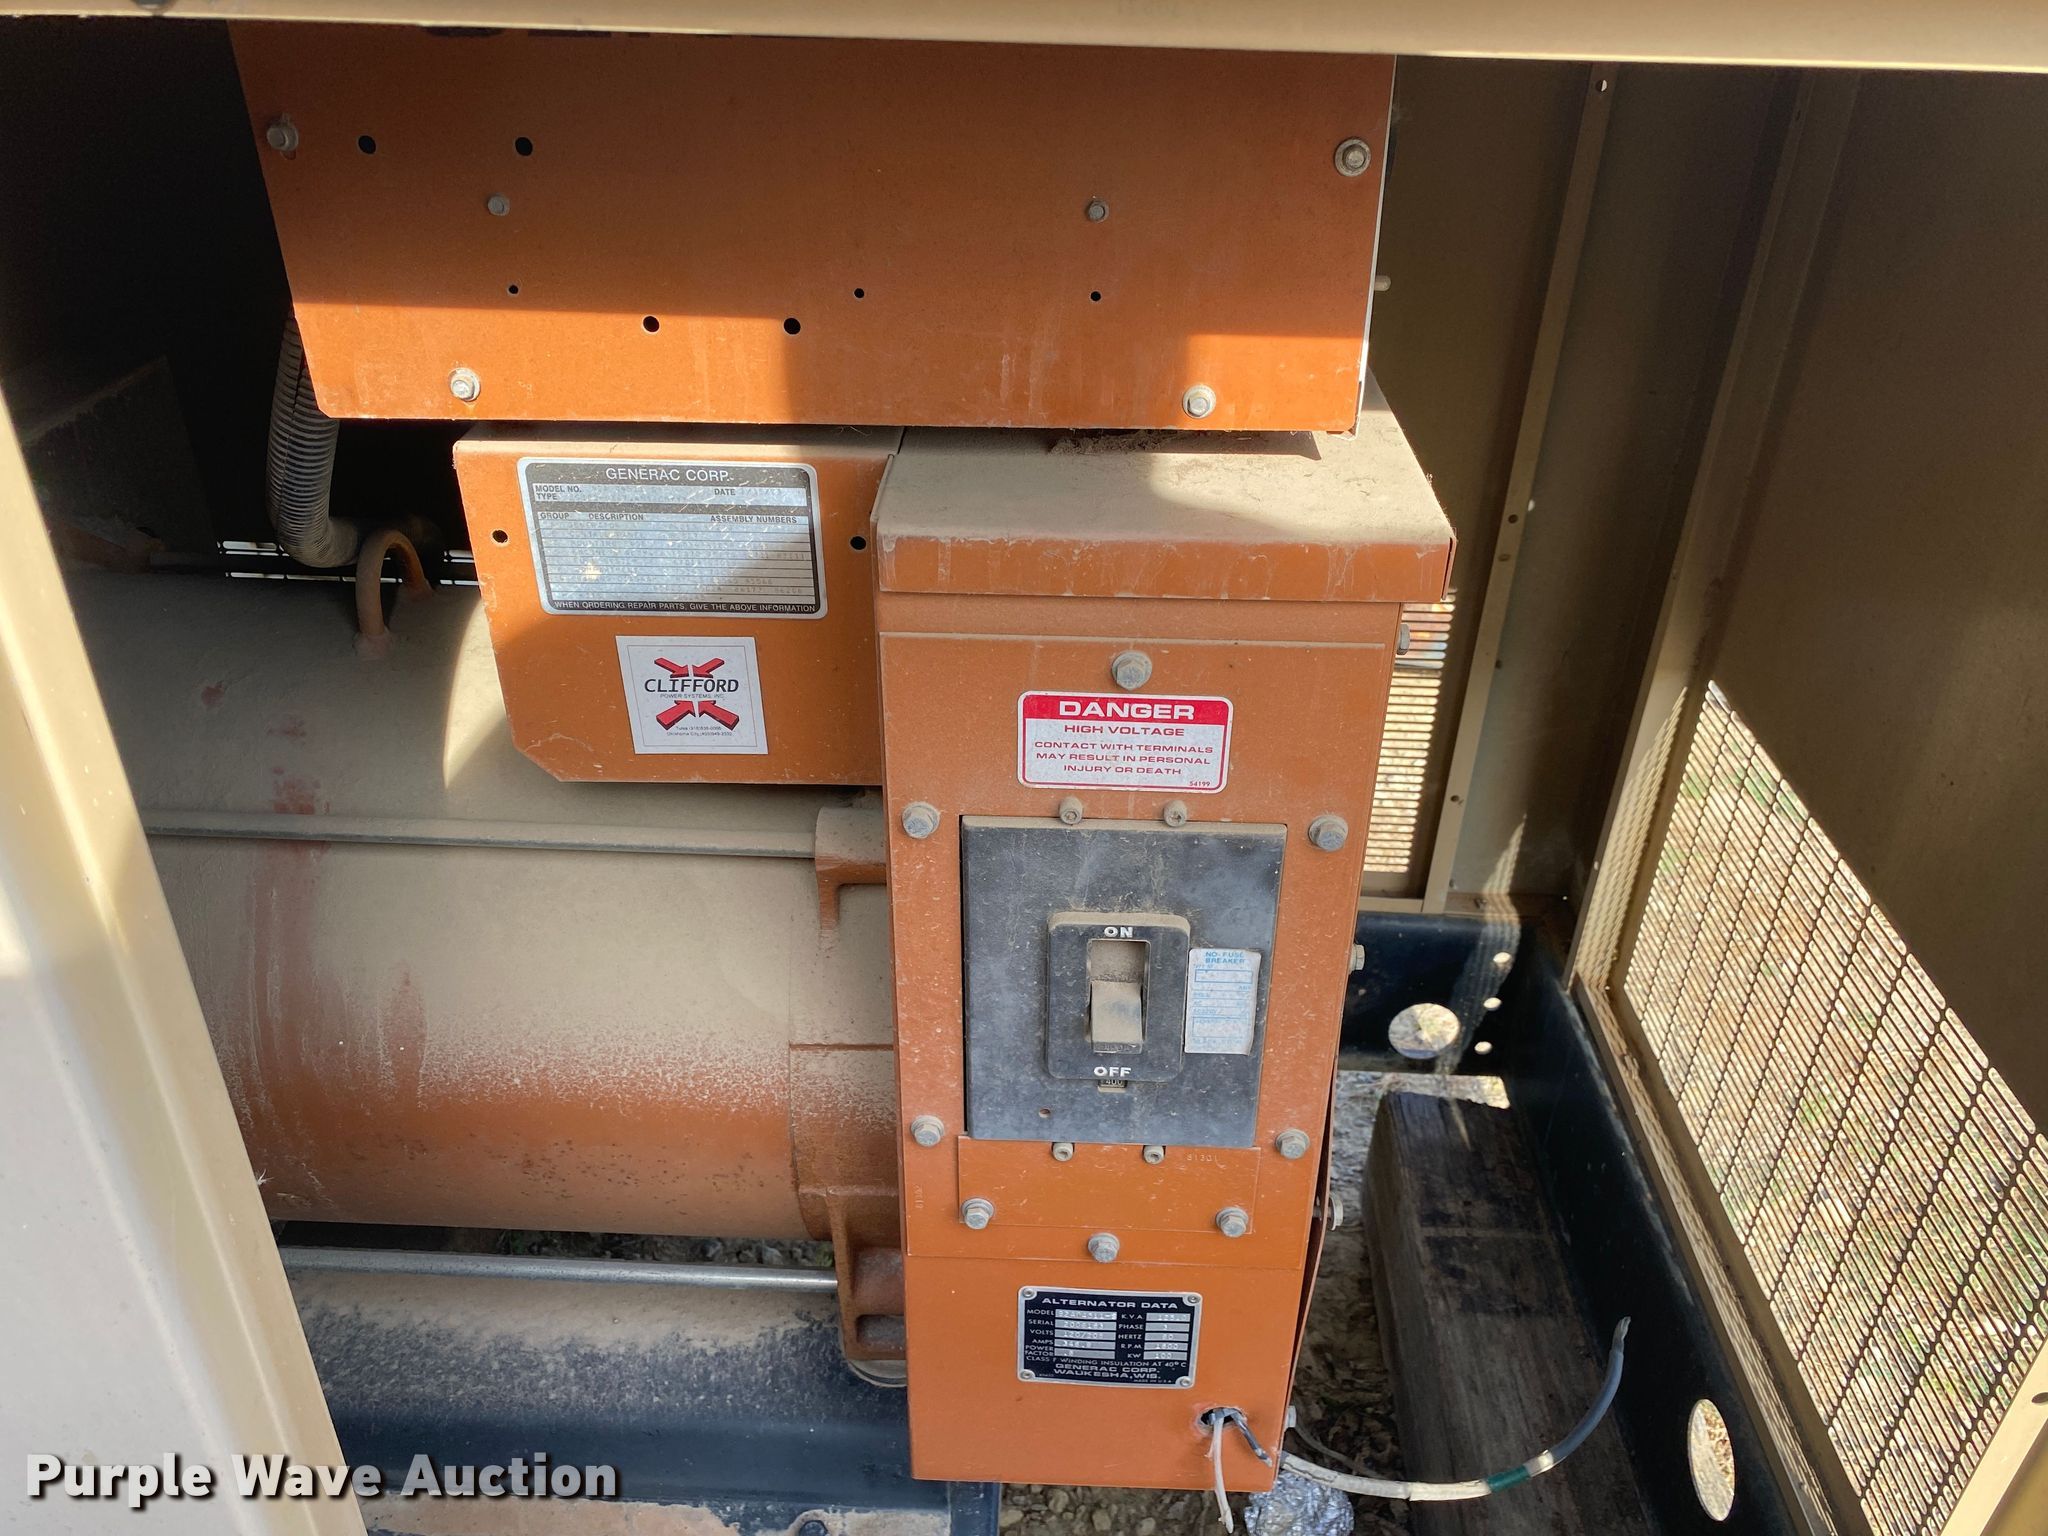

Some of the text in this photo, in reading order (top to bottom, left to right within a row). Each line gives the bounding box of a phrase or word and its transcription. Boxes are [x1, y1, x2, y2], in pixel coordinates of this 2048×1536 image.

[605, 467, 730, 482] GENERAC CORP.
[535, 485, 565, 493] MODEL
[714, 488, 736, 496] DATE
[540, 512, 570, 520] GROUP
[588, 513, 644, 521] DESCRIPTION
[710, 515, 797, 524] ASSEMBLY NUMBERS
[554, 601, 580, 609] WHEN
[582, 602, 625, 610] ORDERING
[627, 602, 657, 611] REPAIR
[689, 603, 711, 611] GIVE
[729, 604, 757, 612] ABOVE
[759, 605, 815, 613] INFORMATION
[644, 679, 739, 693] CLIFFORD
[1059, 700, 1195, 720] DANGER
[1064, 725, 1185, 736] HIGH VOLTAGE
[1034, 741, 1213, 754] CONTACT WITH TERMINALS
[1036, 752, 1066, 760] MAY
[1069, 753, 1120, 762] RESULT
[1139, 756, 1210, 765] PERSONAL
[1064, 765, 1111, 773] INJURY
[1136, 767, 1181, 775] DEATH
[1104, 926, 1133, 938] ON
[1094, 1067, 1131, 1077] OFF
[1042, 1297, 1136, 1308] ALTERNATOR
[1055, 1363, 1117, 1372] GENERAC
